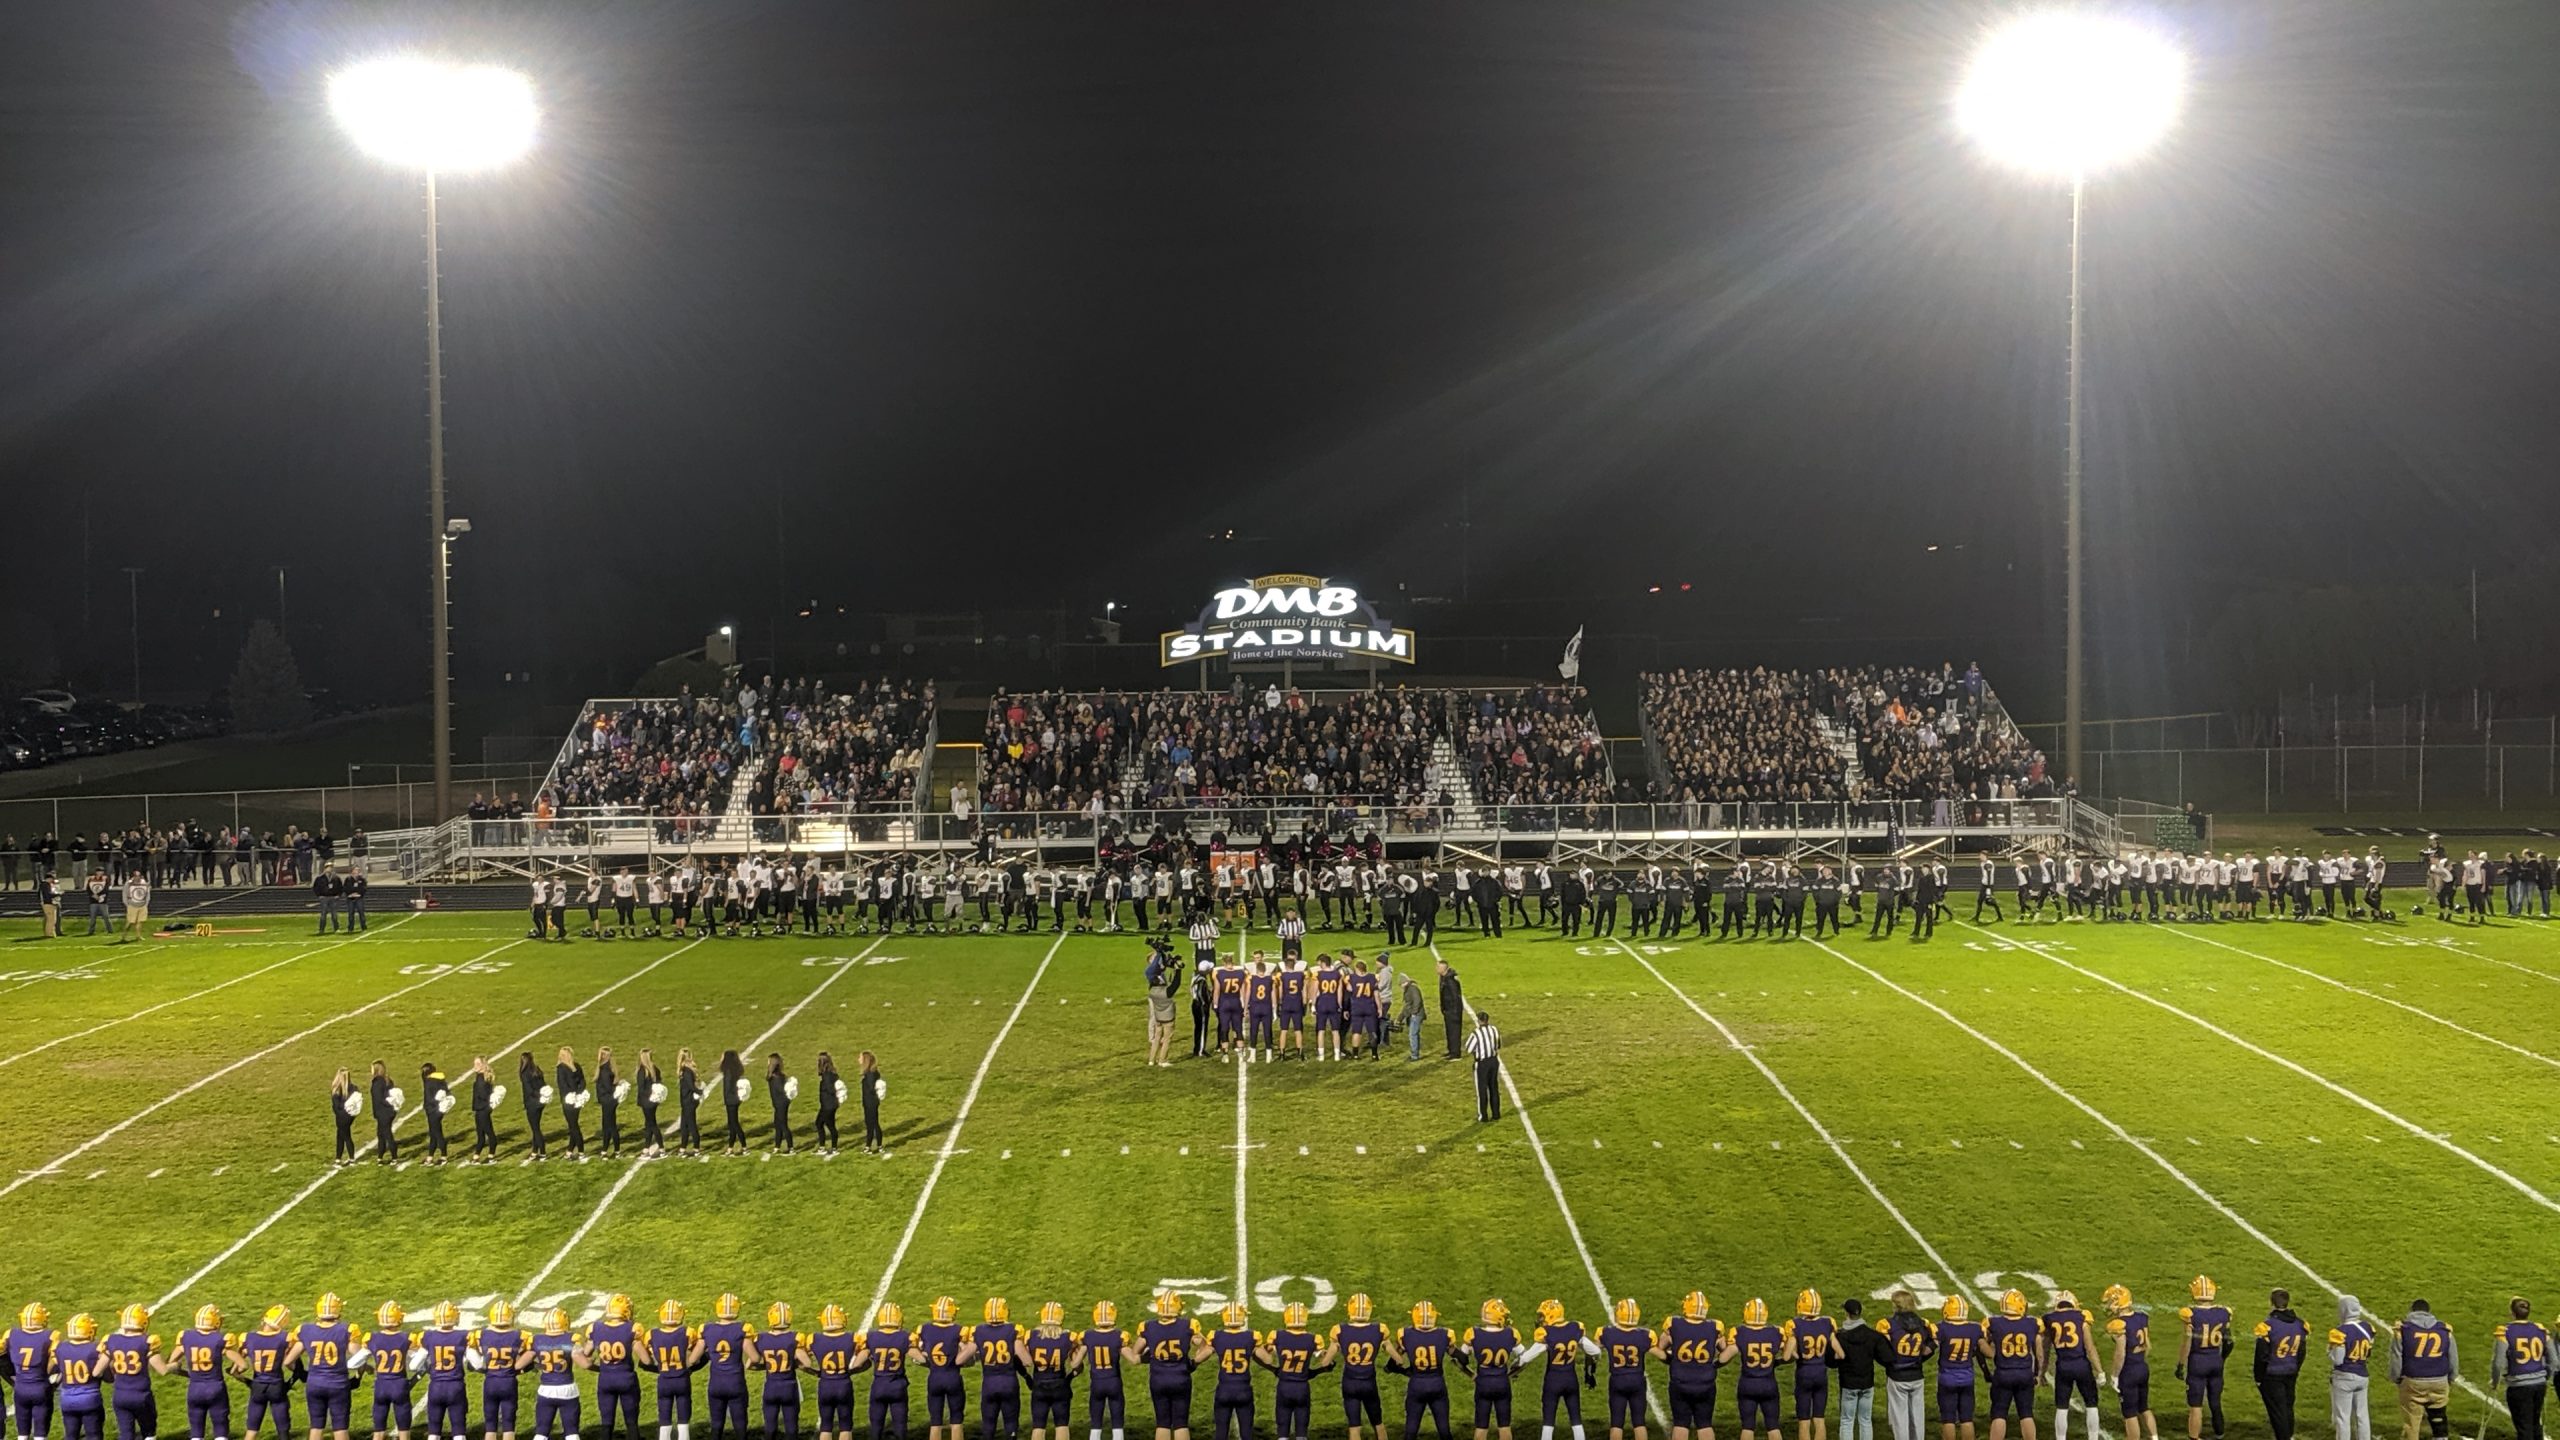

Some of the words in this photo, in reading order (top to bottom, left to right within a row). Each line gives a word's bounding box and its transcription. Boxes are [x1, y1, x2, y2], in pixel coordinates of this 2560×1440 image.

[1256, 576, 1304, 587] WELCOME
[1305, 577, 1319, 587] TO
[1213, 587, 1358, 618] DMB
[1229, 617, 1308, 630] Community
[1310, 617, 1347, 629] Bank
[1169, 629, 1408, 657] STADIUM
[1233, 649, 1262, 659] Home
[1262, 648, 1275, 660] of
[1277, 648, 1294, 657] the
[1296, 648, 1345, 659] Norskies
[196, 925, 210, 936] 20
[1223, 978, 1240, 992] 75
[1256, 984, 1266, 999] 8
[1288, 979, 1298, 994] 5
[1321, 979, 1337, 994] 90
[1355, 983, 1371, 998] 74
[1802, 1333, 1827, 1360] 30
[1897, 1332, 1923, 1357] 62
[2001, 1332, 2028, 1358] 68
[2051, 1321, 2080, 1349] 23
[2200, 1322, 2223, 1348] 16
[2276, 1334, 2301, 1359] 64
[2414, 1331, 2443, 1358] 72
[19, 1348, 34, 1371] 7
[191, 1346, 213, 1372] 18
[254, 1349, 277, 1373] 17
[310, 1340, 338, 1366] 70
[376, 1349, 403, 1373] 22
[434, 1345, 456, 1371] 15
[487, 1346, 514, 1370] 25
[540, 1350, 568, 1373] 35
[600, 1341, 626, 1365] 80
[659, 1345, 683, 1372] 14
[716, 1339, 731, 1363] 9
[763, 1349, 791, 1373] 52
[875, 1347, 901, 1371] 73
[932, 1342, 947, 1366] 6
[983, 1339, 1010, 1366] 28
[1034, 1347, 1061, 1372] 54
[1094, 1346, 1112, 1370] 11
[1154, 1339, 1183, 1361] 65
[1221, 1348, 1249, 1374] 45
[1281, 1349, 1308, 1373] 27
[1347, 1342, 1374, 1366] 82
[1414, 1345, 1438, 1371] 81
[1480, 1348, 1509, 1368] 20
[1552, 1339, 1578, 1365] 29
[1613, 1344, 1639, 1368] 53
[1677, 1339, 1710, 1364] 66
[1746, 1342, 1773, 1369] 55
[1948, 1338, 1971, 1362] 71
[2349, 1339, 2371, 1363] 40
[2515, 1336, 2544, 1365] 50
[63, 1360, 89, 1384] 10
[113, 1350, 142, 1375] 83
[822, 1351, 846, 1374] 61
